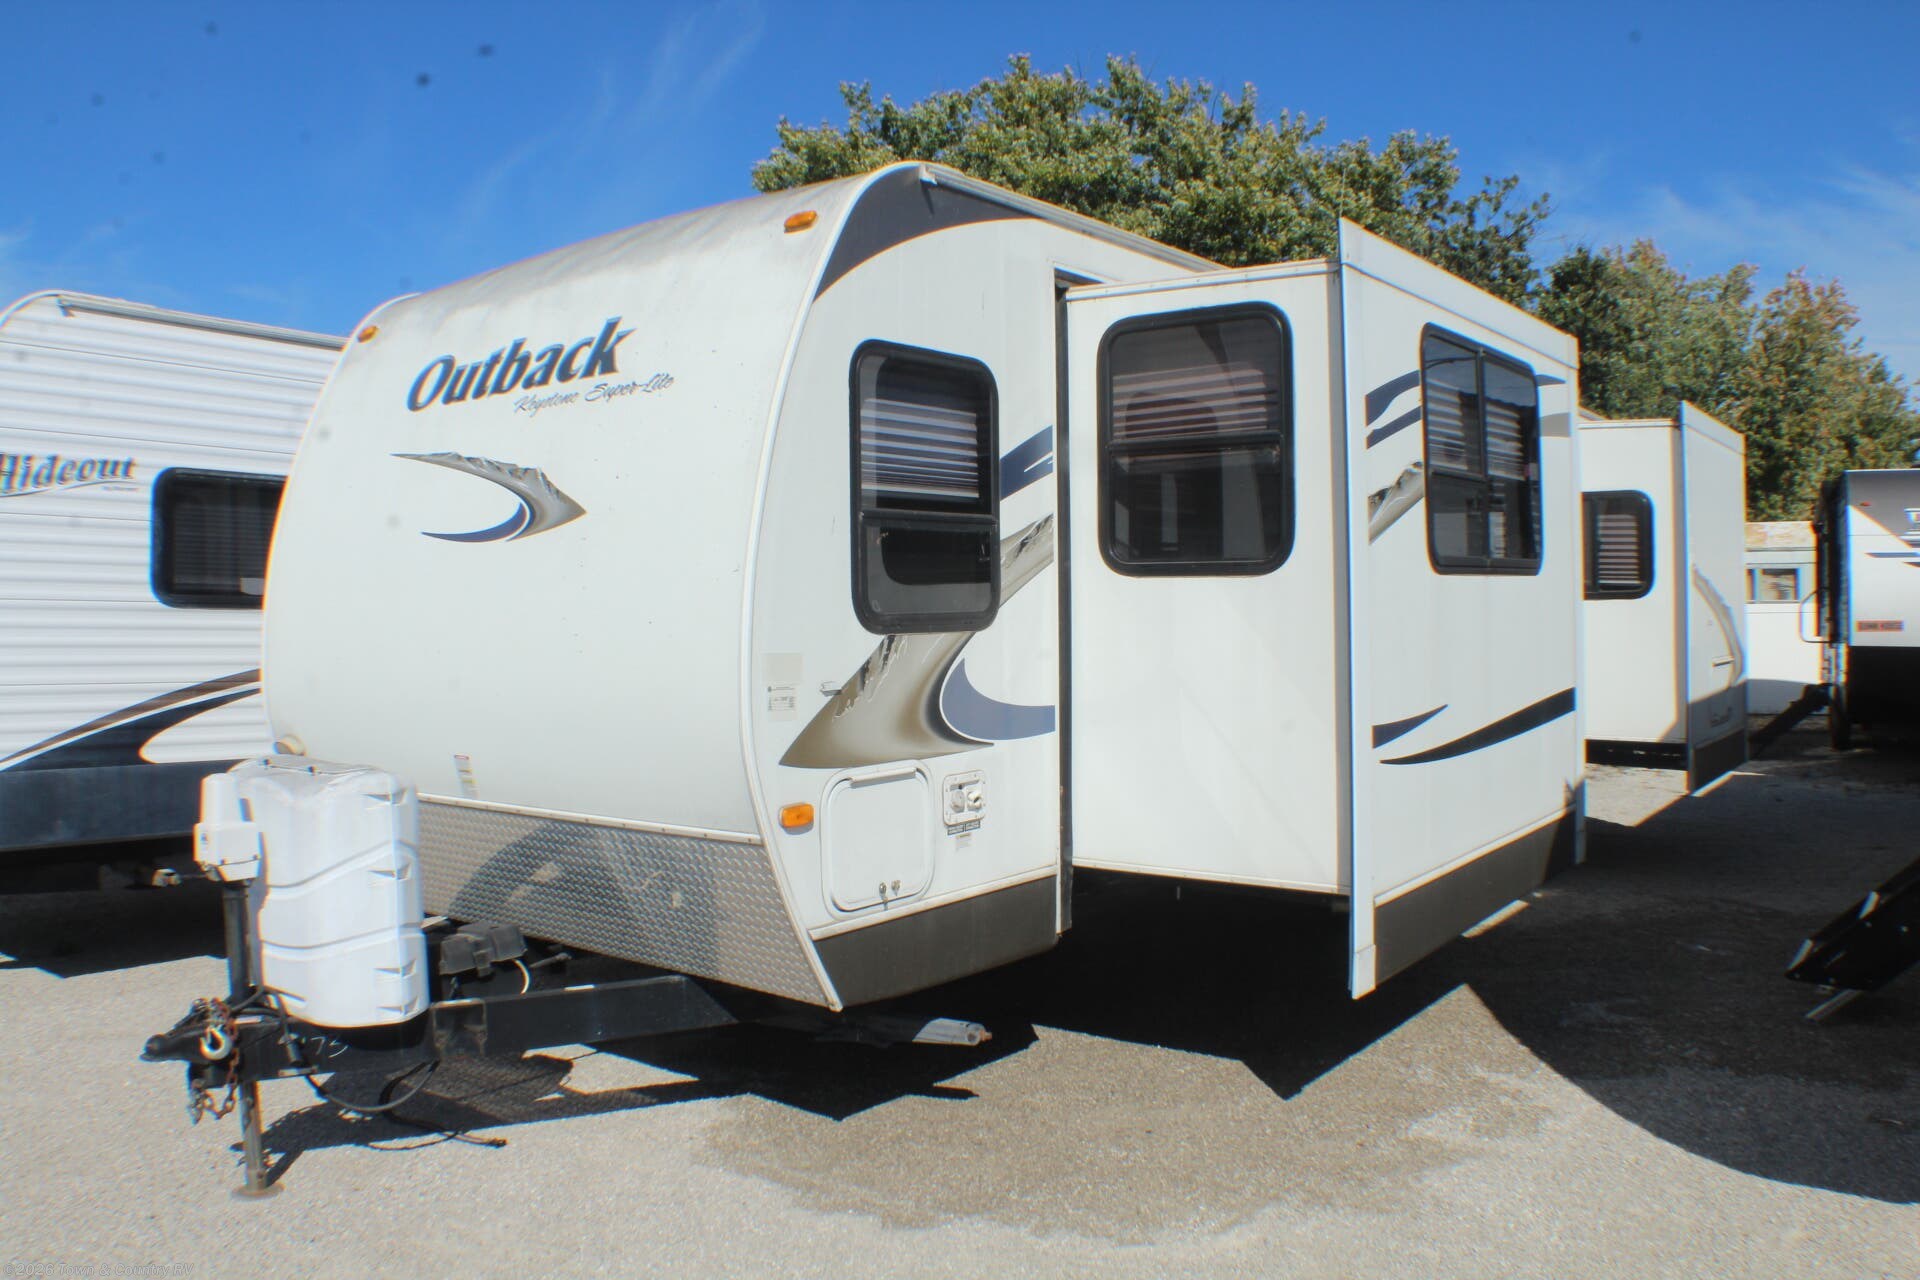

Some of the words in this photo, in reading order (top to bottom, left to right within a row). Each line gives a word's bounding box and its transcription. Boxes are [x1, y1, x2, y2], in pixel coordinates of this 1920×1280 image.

[407, 316, 637, 412] Outback
[513, 391, 579, 418] Keystone
[0, 453, 137, 494] Hideout
